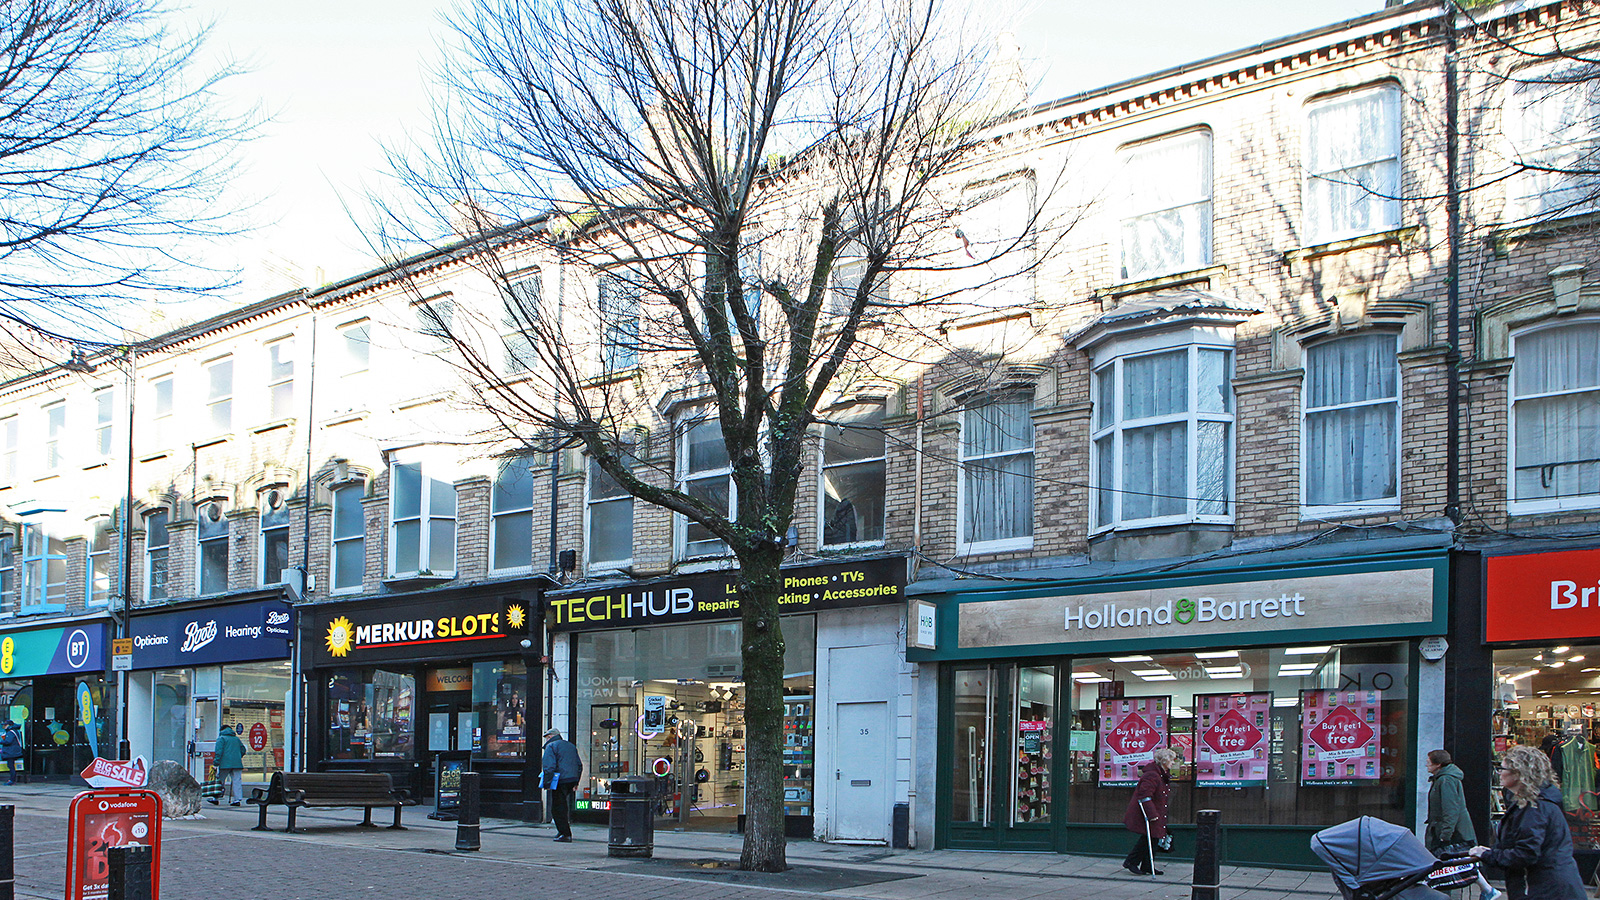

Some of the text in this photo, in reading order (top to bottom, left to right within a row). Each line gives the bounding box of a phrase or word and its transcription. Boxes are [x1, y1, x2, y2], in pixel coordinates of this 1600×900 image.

[784, 576, 829, 588] Phones
[841, 570, 865, 583] TVs
[698, 584, 898, 612] Repairs cking Accessories
[1064, 600, 1172, 630] Holland
[1197, 592, 1306, 622] Barrett
[266, 611, 290, 626] Boots
[266, 626, 289, 634] Opticians
[355, 612, 499, 644] MERKUR SLOTS
[134, 634, 168, 650] Opticians
[180, 620, 218, 652] Boots
[72, 641, 84, 656] BT
[436, 674, 472, 684] WELCOME
[1116, 728, 1129, 736] Buy
[1214, 726, 1228, 734] Buy
[1234, 726, 1245, 734] get
[1322, 723, 1336, 731] Buy
[1344, 723, 1356, 731] get
[1121, 736, 1145, 748] free
[1220, 734, 1245, 746] free
[1328, 732, 1355, 744] free
[96, 760, 113, 772] BIG
[111, 765, 144, 786] SALE
[576, 801, 588, 809] DAY
